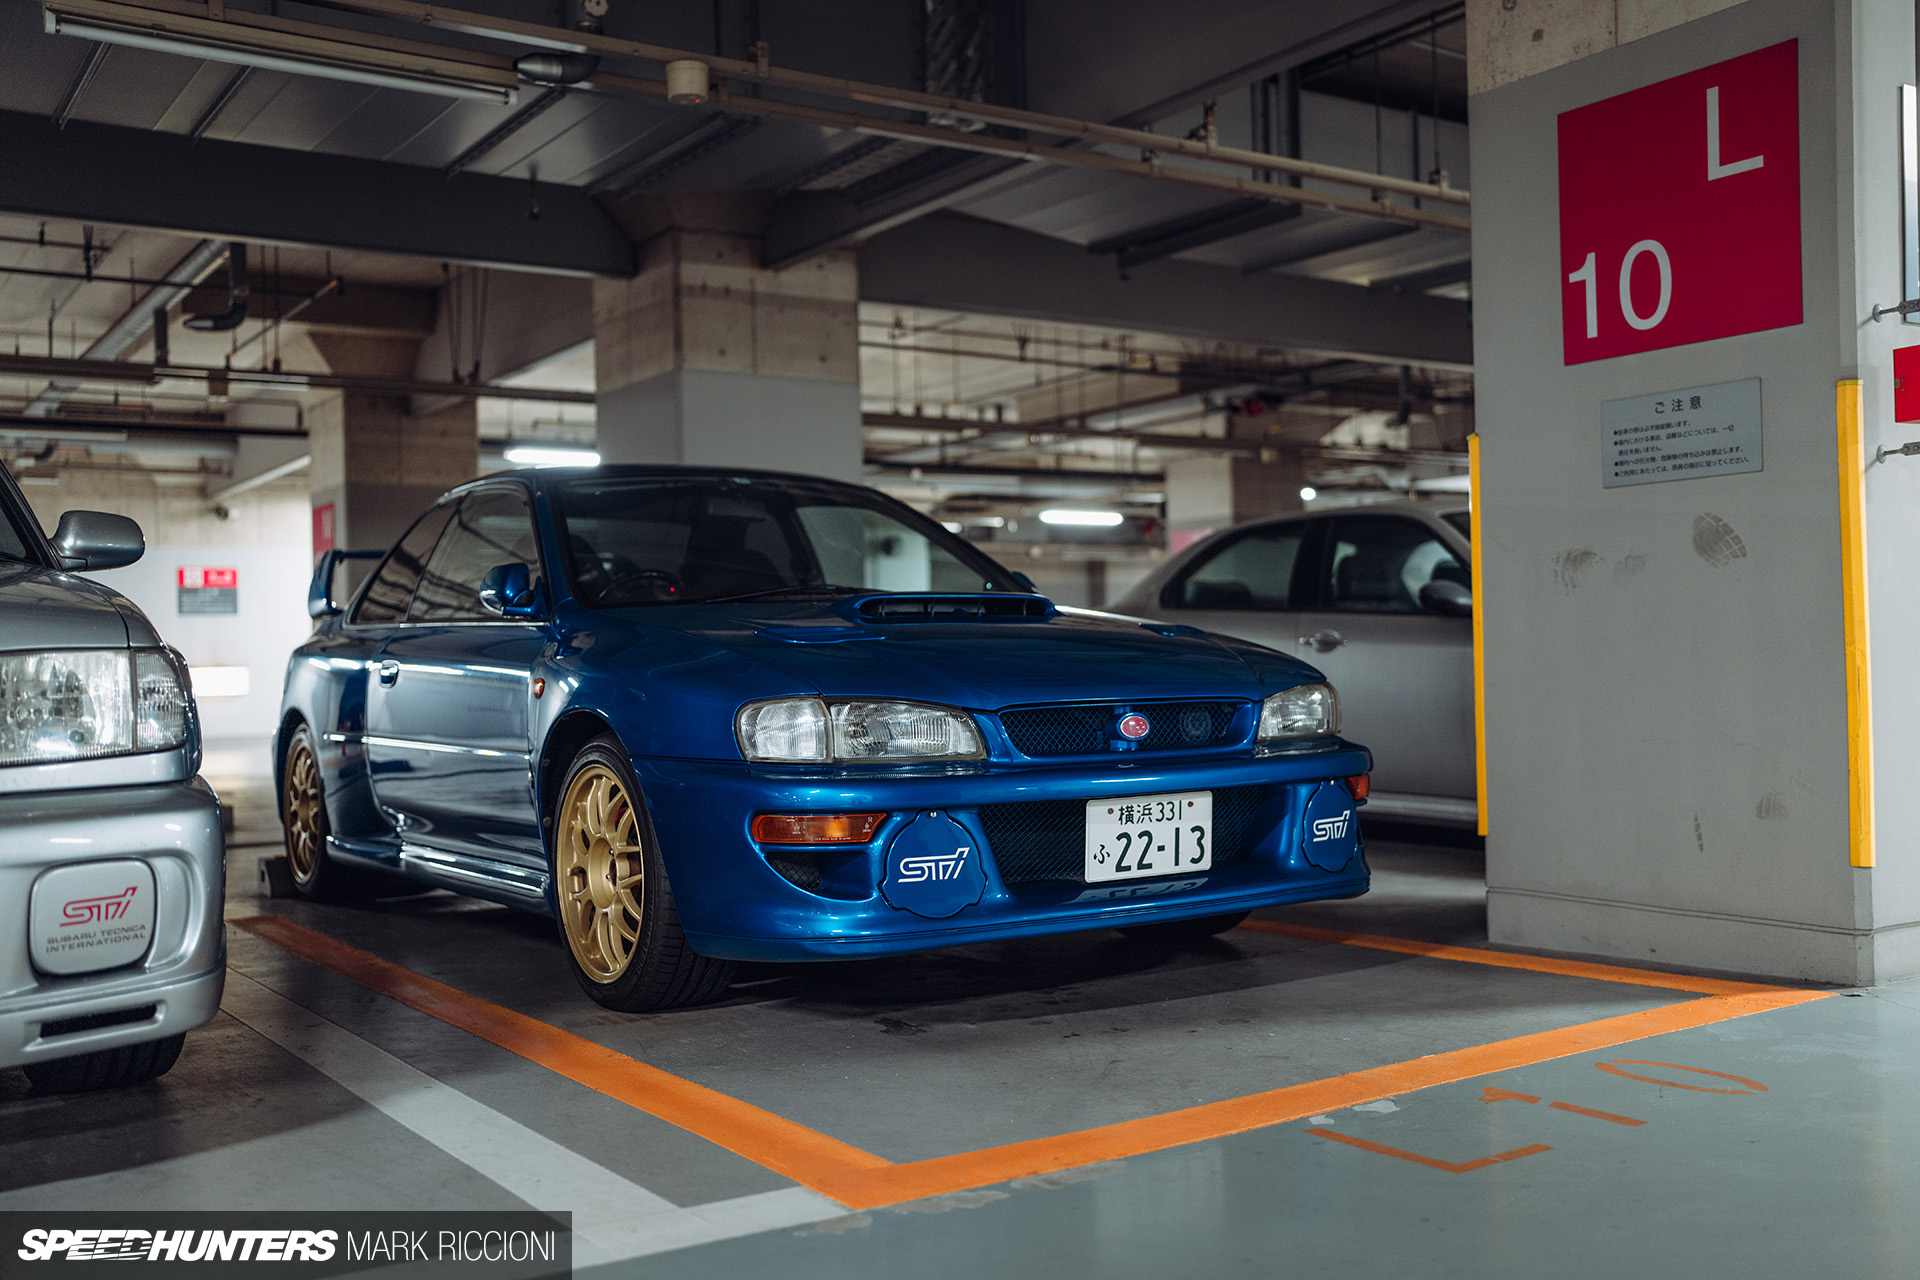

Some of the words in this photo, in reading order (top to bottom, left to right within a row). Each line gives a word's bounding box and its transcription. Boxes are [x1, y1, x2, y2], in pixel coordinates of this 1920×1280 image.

[1706, 86, 1764, 181] L
[1568, 239, 1672, 339] 10
[1654, 395, 1702, 414] ご注意
[1093, 844, 1111, 864] ふ
[1115, 825, 1205, 873] 22-13
[45, 932, 146, 953] INTERNATIONAL
[47, 932, 97, 945] SUBARU
[100, 923, 147, 936] TECNICA
